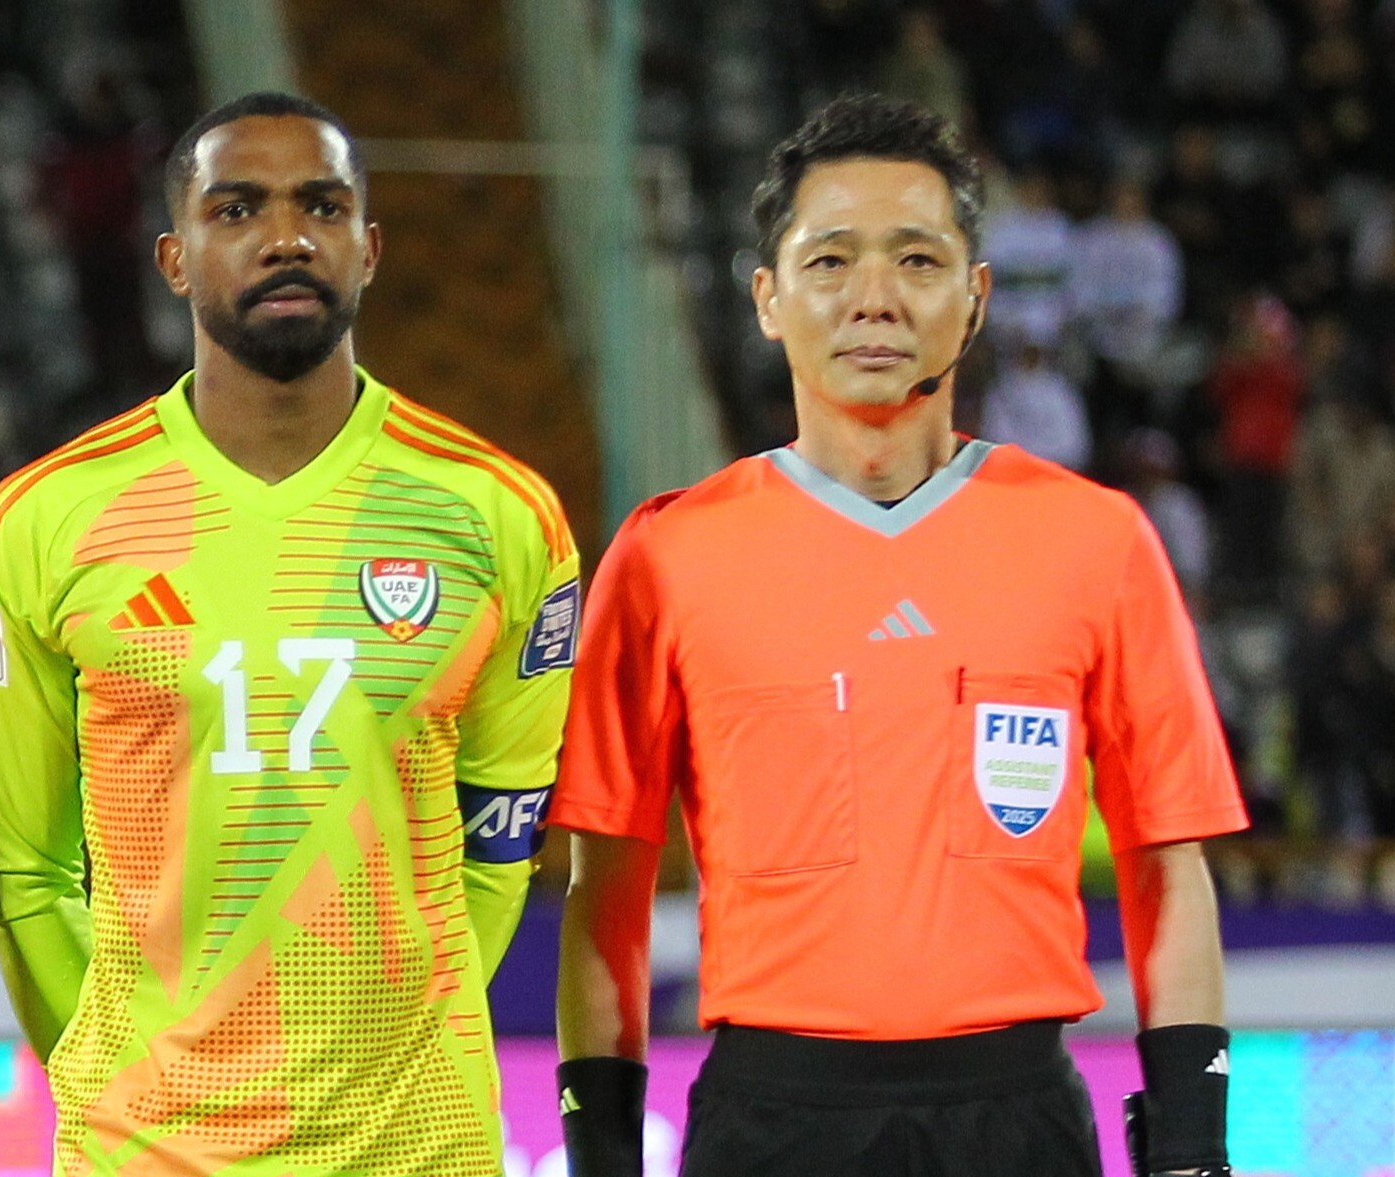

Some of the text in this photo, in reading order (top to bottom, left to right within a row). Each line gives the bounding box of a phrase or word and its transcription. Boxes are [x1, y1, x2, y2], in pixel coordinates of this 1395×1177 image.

[381, 580, 419, 593] UAE
[390, 594, 411, 604] FA
[201, 637, 356, 775] 17
[985, 712, 1061, 748] FIFA
